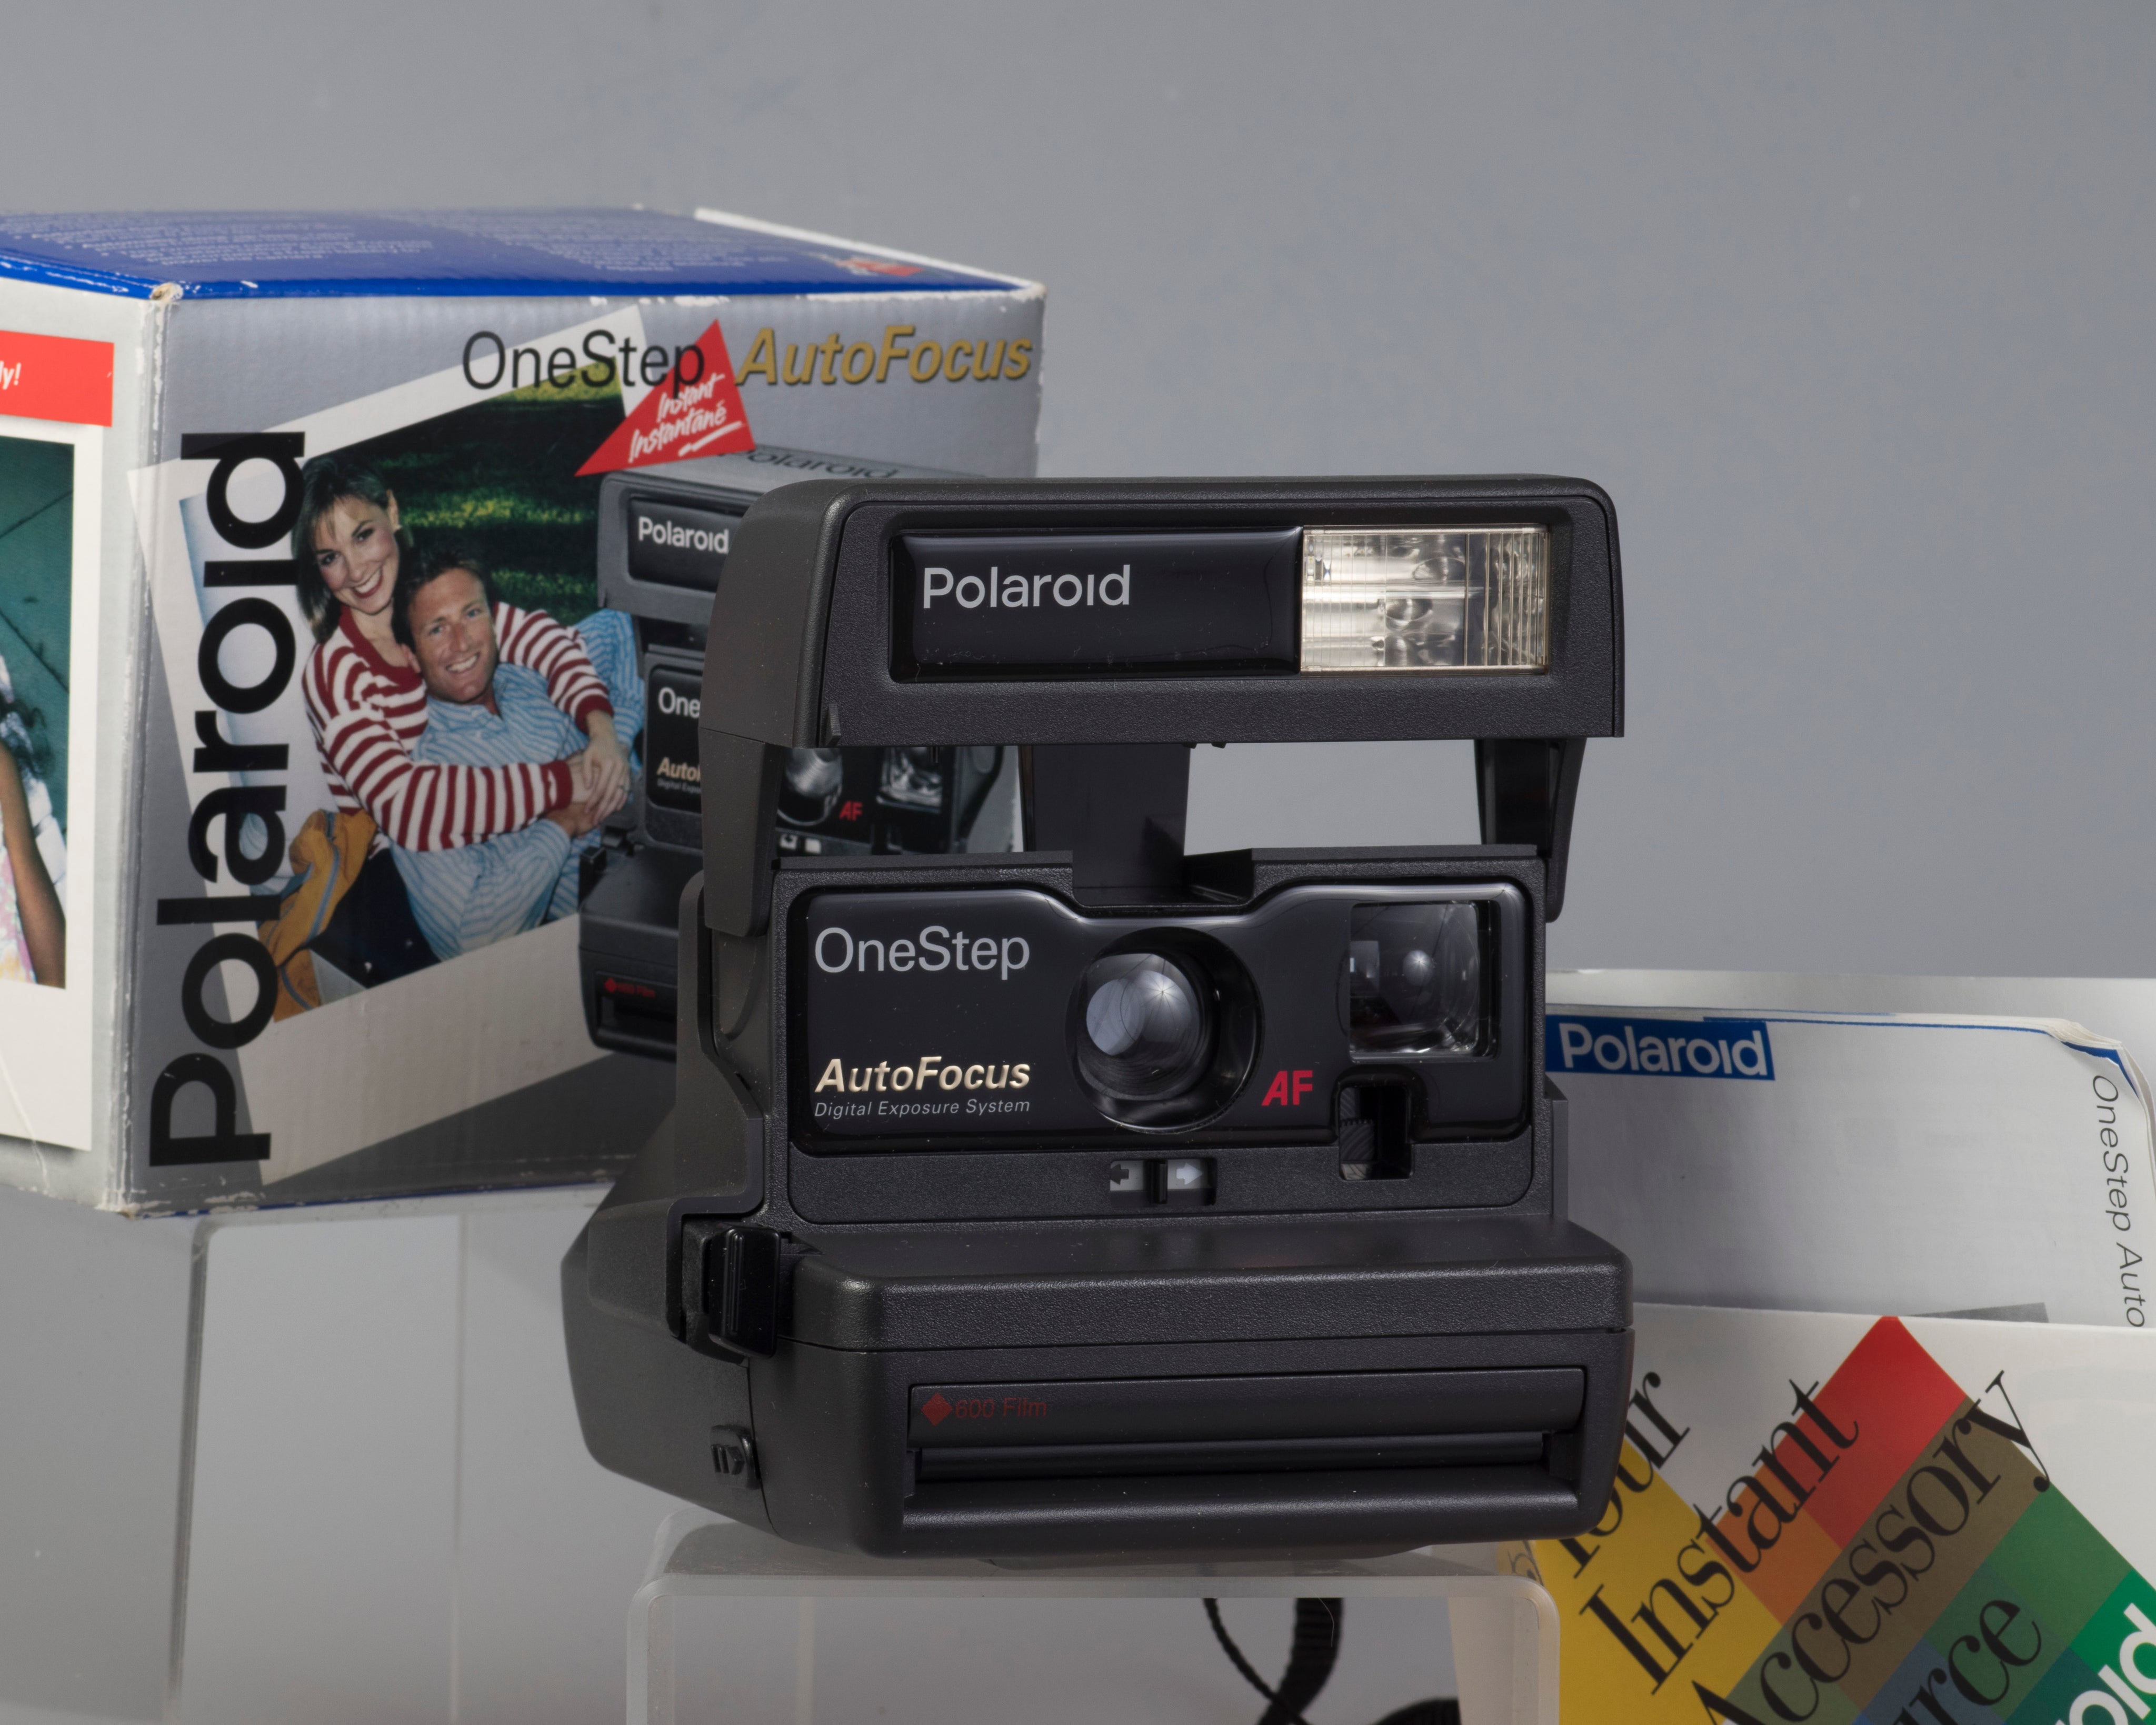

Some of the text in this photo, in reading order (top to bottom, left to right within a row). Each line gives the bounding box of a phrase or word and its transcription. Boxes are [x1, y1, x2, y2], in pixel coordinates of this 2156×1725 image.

[462, 324, 1033, 399] OneStep AutoFocus
[732, 450, 899, 478] olaroid
[638, 515, 730, 555] Polaroid
[923, 564, 1131, 609] Polaroid
[656, 756, 701, 783] Auto
[149, 432, 306, 1167] Polaroid
[839, 800, 863, 822] AF
[815, 925, 1030, 981] OneStep
[1558, 1022, 1768, 1076] Polaroid
[814, 1056, 1031, 1093] AutoFocus
[1261, 1070, 1313, 1106] AF
[814, 1098, 1031, 1120] Digital Exposure System
[2092, 1074, 2145, 1328] OneStep Auto
[954, 1397, 1048, 1419] 600 Film
[1579, 1378, 1860, 1697] Instant
